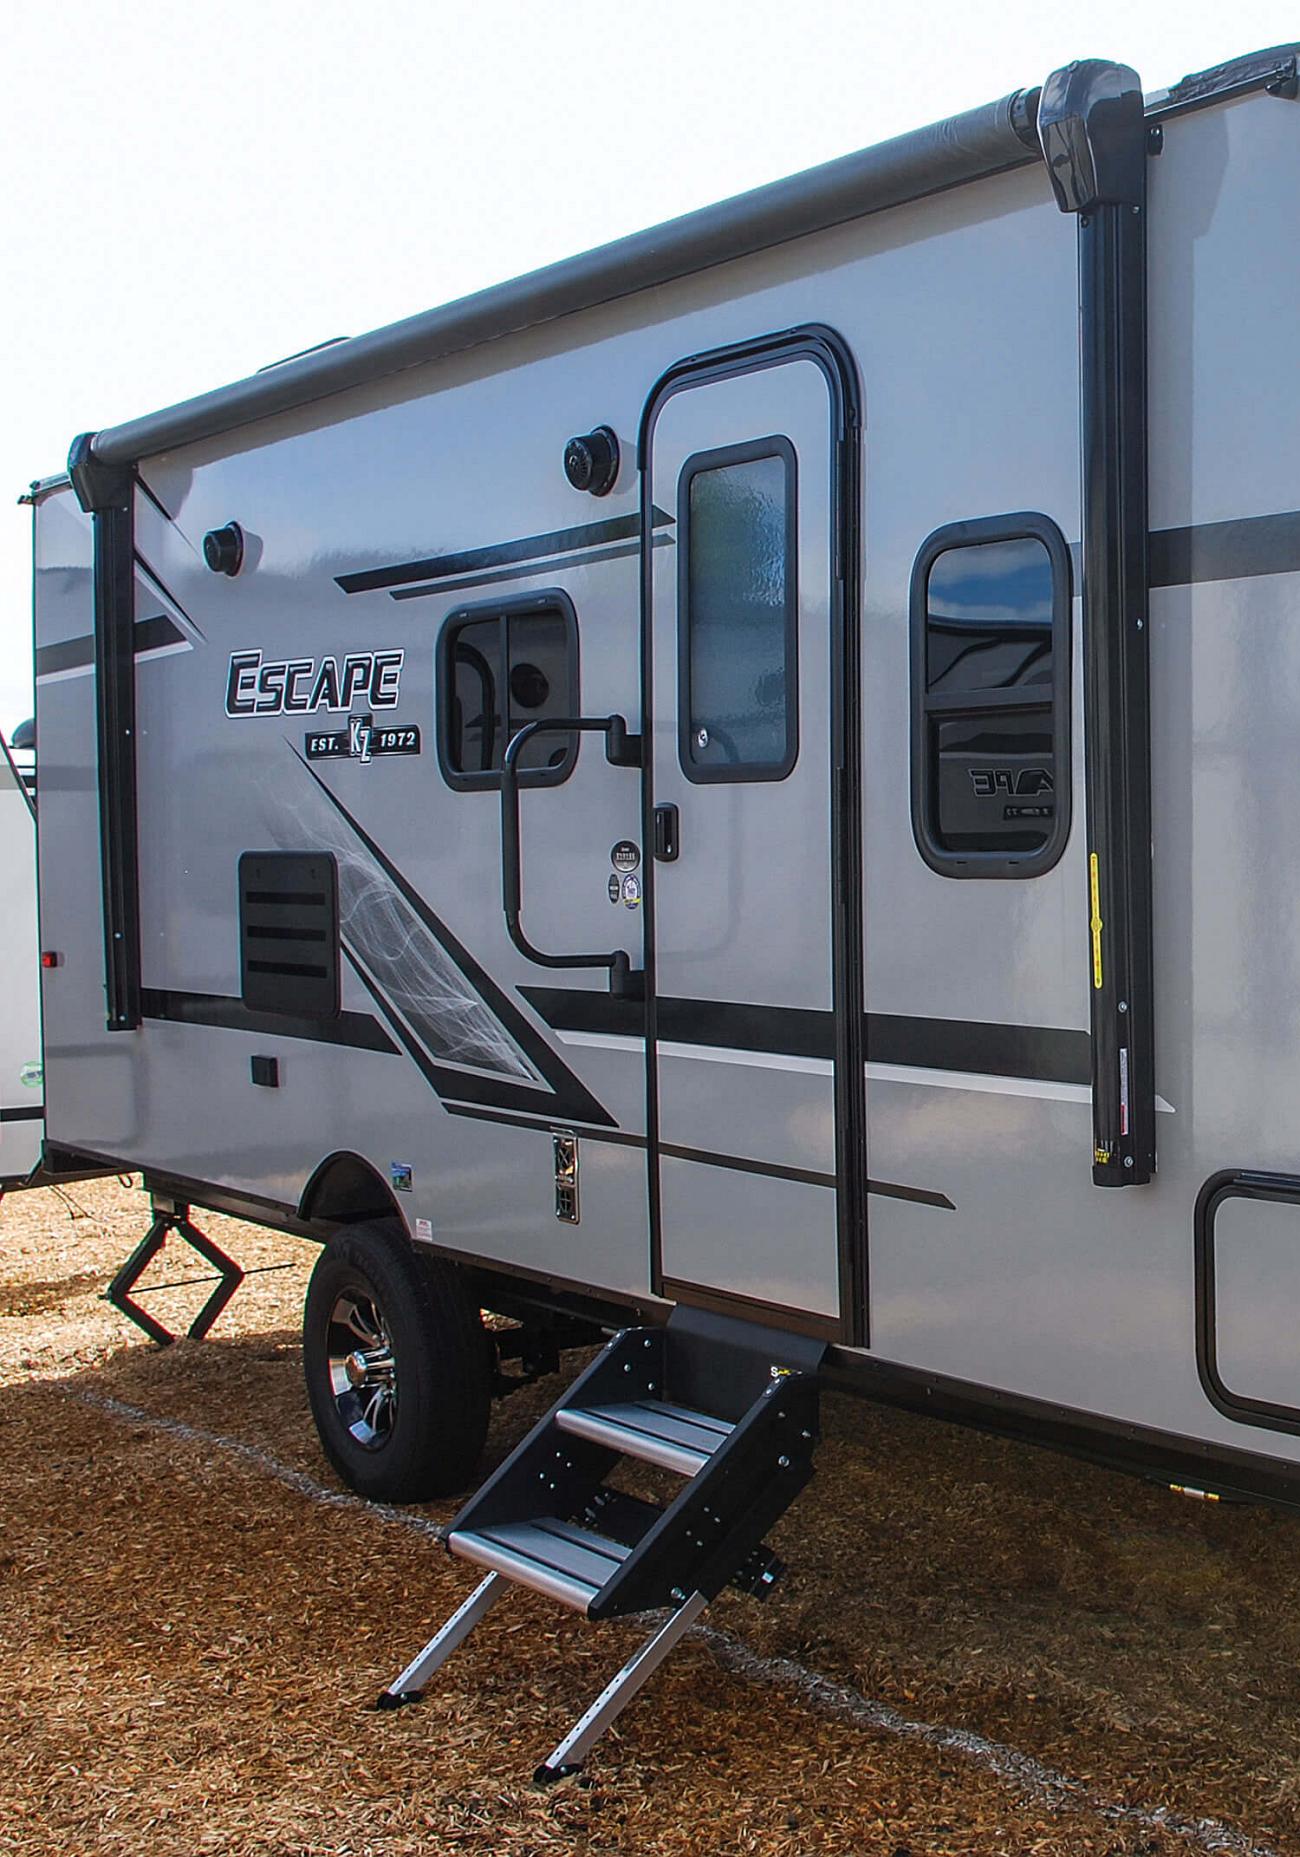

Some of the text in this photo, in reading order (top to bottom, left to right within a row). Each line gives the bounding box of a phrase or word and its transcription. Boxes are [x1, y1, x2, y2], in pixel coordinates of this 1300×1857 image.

[225, 648, 404, 719] ESCAPE
[310, 737, 339, 752] EST.
[380, 731, 416, 748] 1972
